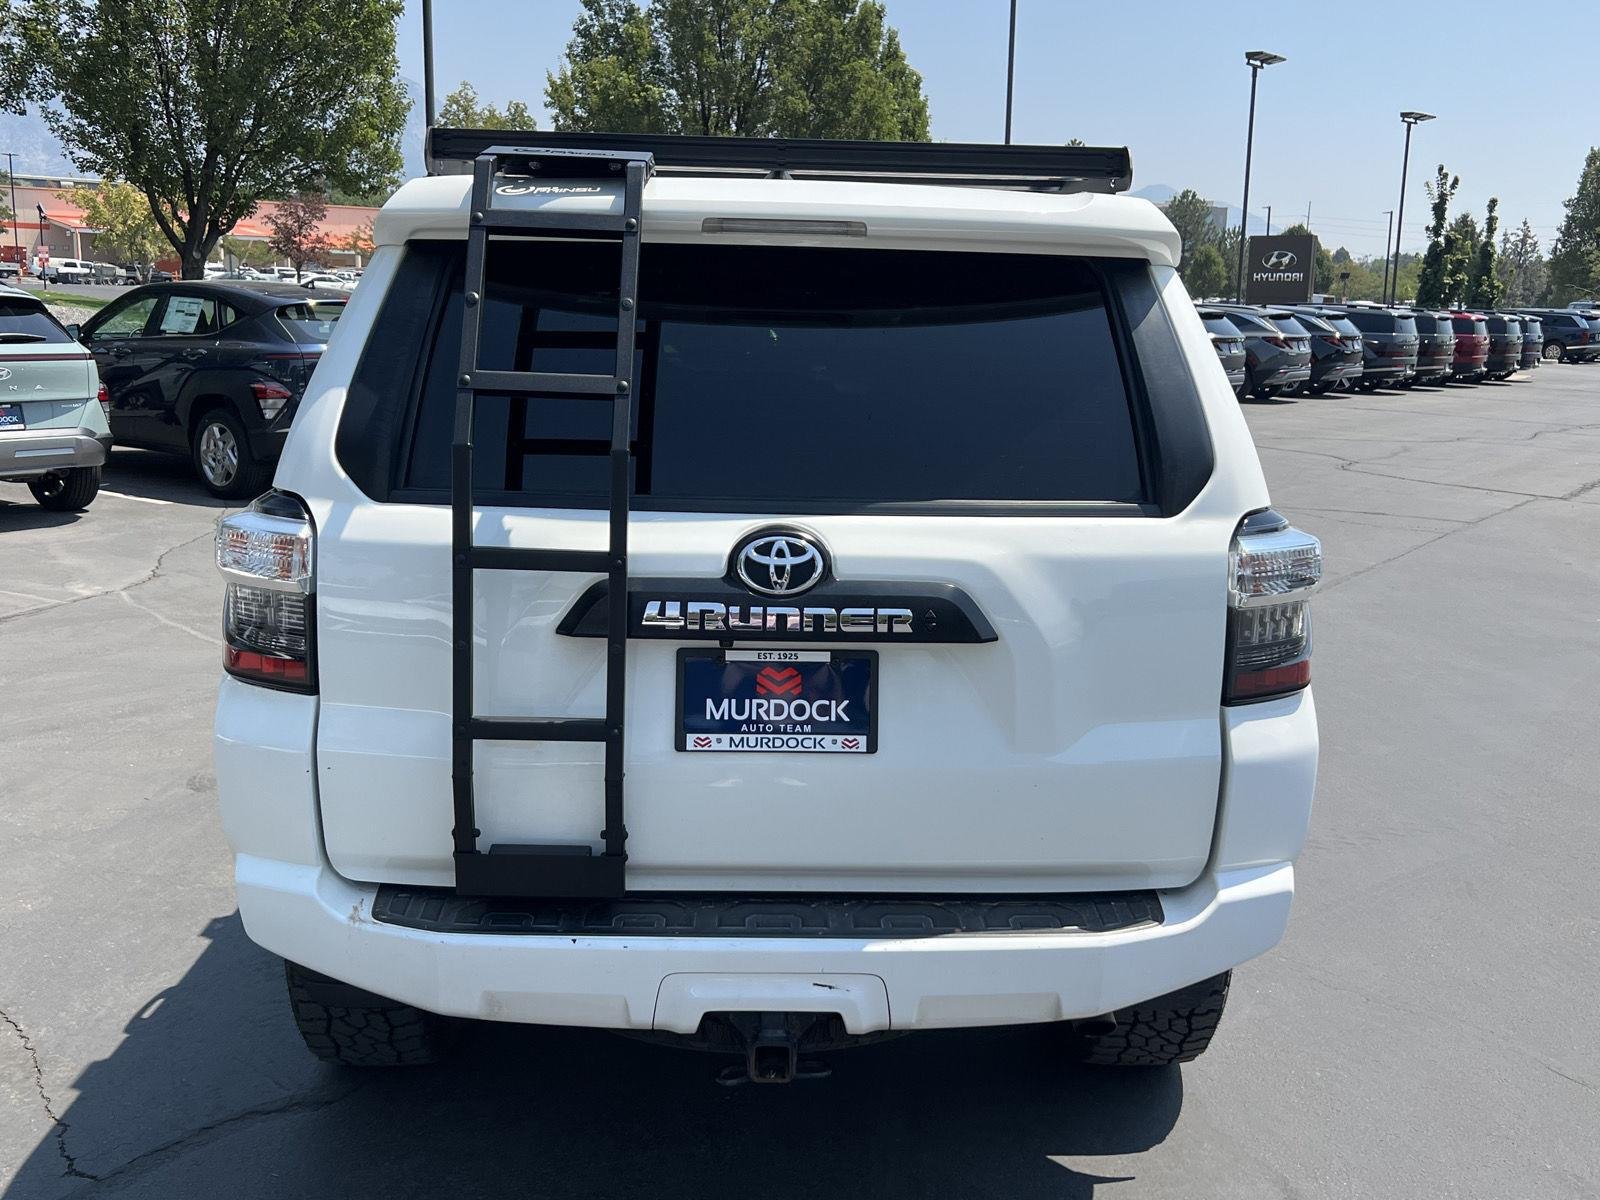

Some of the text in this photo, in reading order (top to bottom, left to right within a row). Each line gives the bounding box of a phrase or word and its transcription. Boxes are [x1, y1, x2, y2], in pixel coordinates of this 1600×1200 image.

[1253, 272, 1304, 282] HYUNDAI
[641, 600, 914, 633] 4RUNNER
[757, 652, 799, 660] EST. 1925
[705, 698, 851, 722] MURDOCK
[741, 724, 812, 733] AUTO TEAM
[729, 736, 826, 749] MURDOCK
